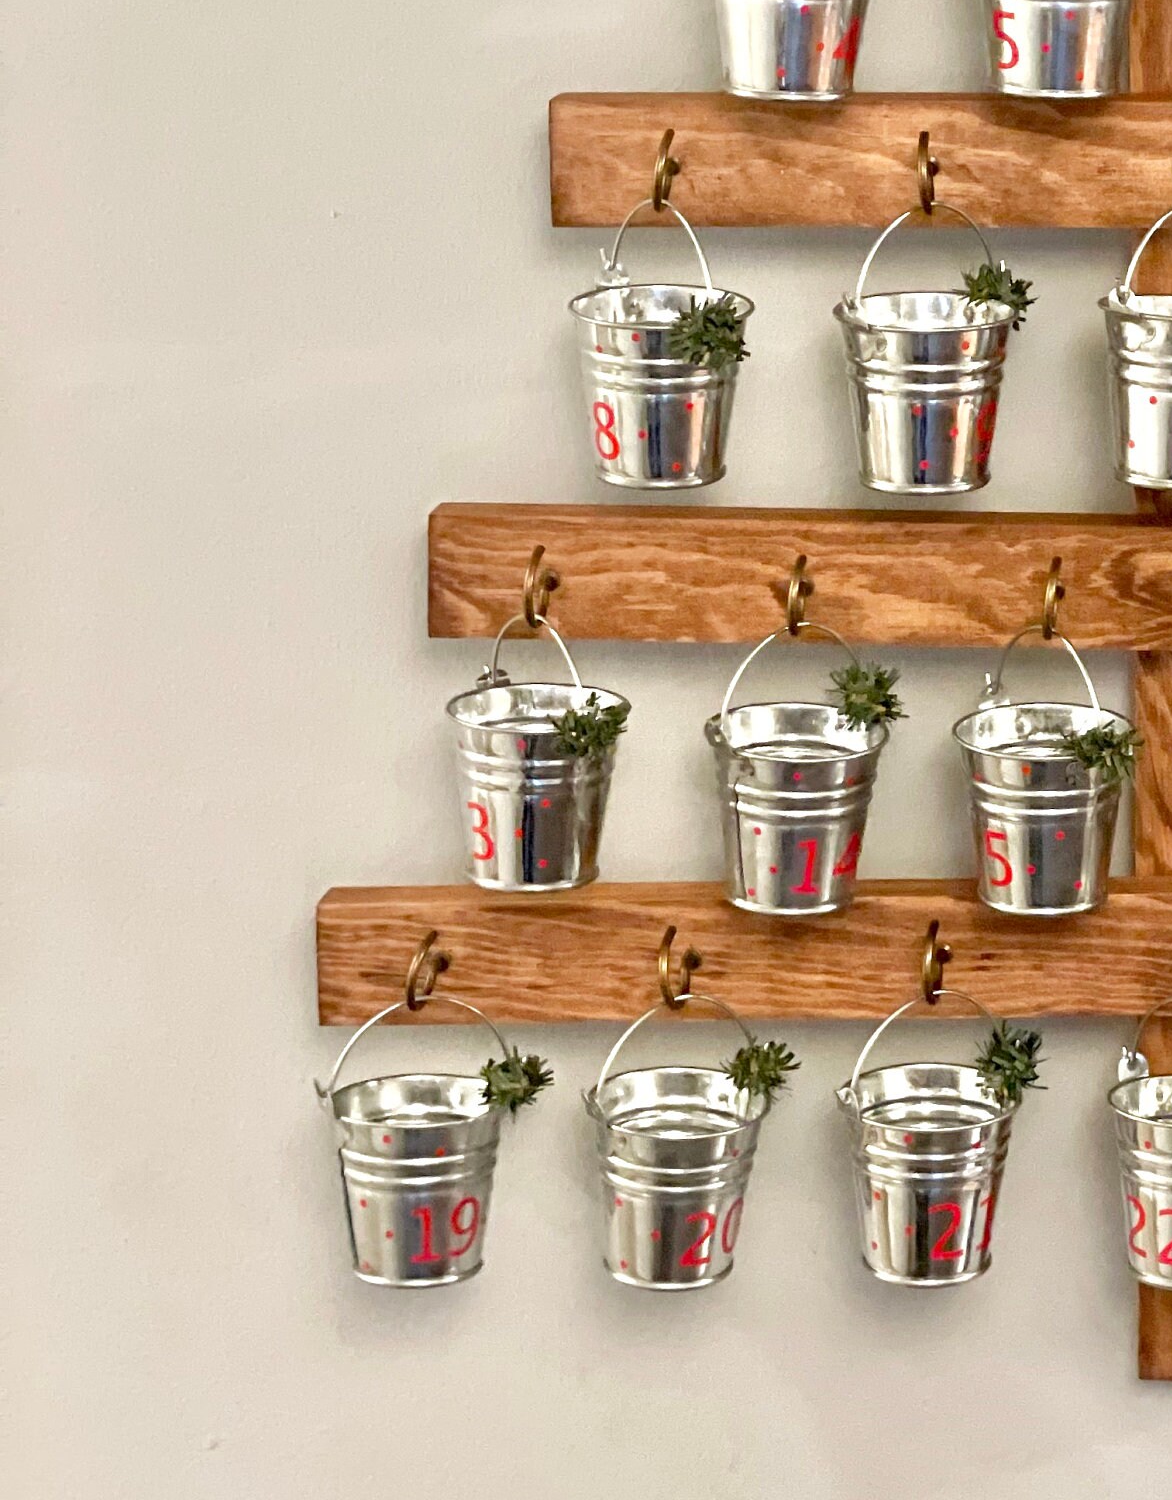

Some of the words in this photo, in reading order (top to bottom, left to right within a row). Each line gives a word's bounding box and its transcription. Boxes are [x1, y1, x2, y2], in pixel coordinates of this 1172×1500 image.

[993, 9, 1019, 68] 5
[592, 401, 621, 460] 8
[411, 1197, 480, 1263] 19
[679, 1197, 745, 1268] 20
[927, 1193, 994, 1262] 21
